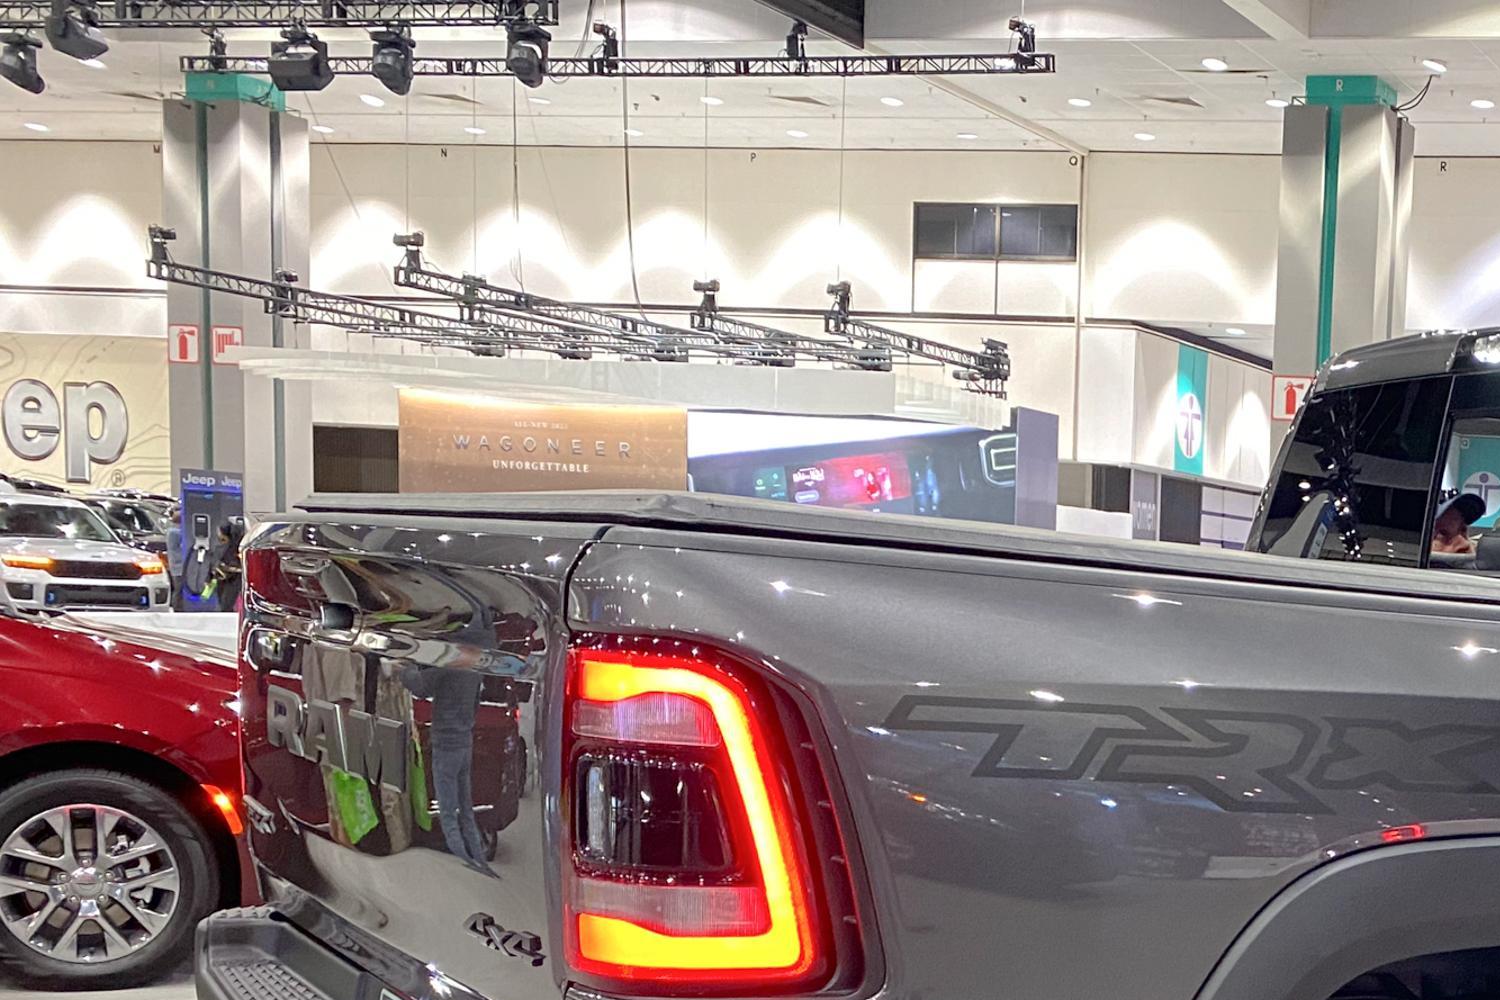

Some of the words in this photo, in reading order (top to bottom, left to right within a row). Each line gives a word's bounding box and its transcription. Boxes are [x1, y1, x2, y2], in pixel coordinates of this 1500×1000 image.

[1335, 79, 1343, 92] R
[440, 147, 448, 158] N
[750, 152, 757, 163] P
[1440, 161, 1447, 172] R
[453, 434, 631, 458] WAGONEER
[492, 459, 590, 473] UNFORGETTABLE
[182, 473, 216, 488] Jeep
[221, 475, 243, 490] Jeep
[266, 684, 407, 793] RAM
